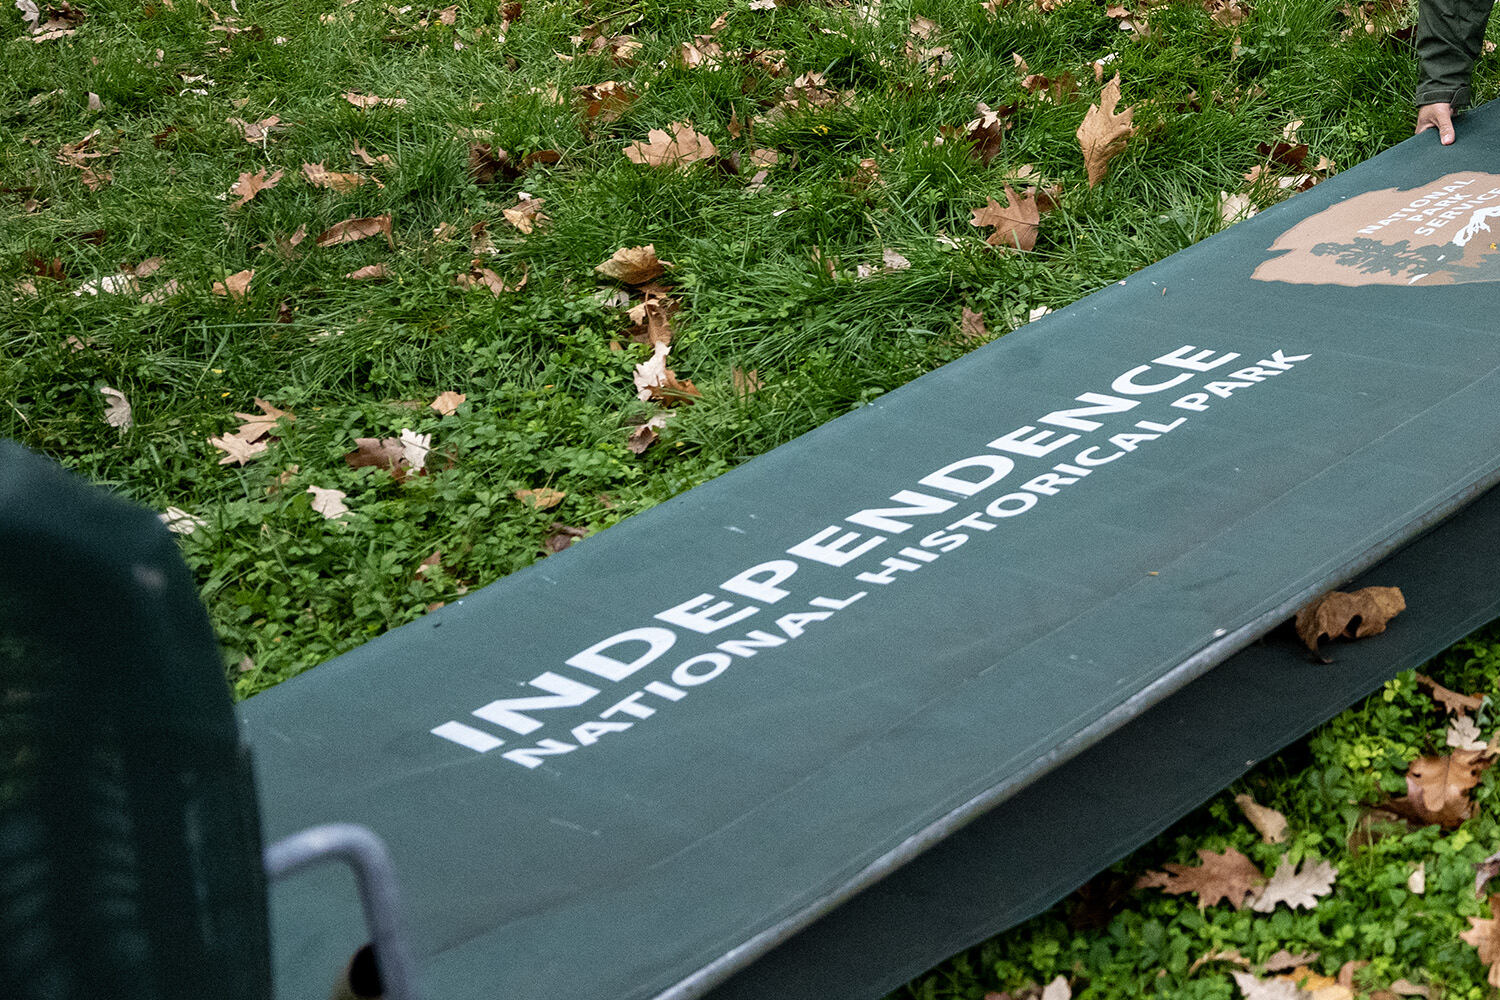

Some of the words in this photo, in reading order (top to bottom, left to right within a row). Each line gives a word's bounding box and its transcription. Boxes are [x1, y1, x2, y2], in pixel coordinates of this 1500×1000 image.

[1357, 178, 1476, 234] NATIONAL
[1406, 193, 1473, 222] PARK
[430, 345, 1241, 753] INDEPENDENCE
[502, 591, 867, 769] NATIONAL
[855, 417, 1188, 586] HISTORICAL
[1170, 348, 1313, 412] PARK
